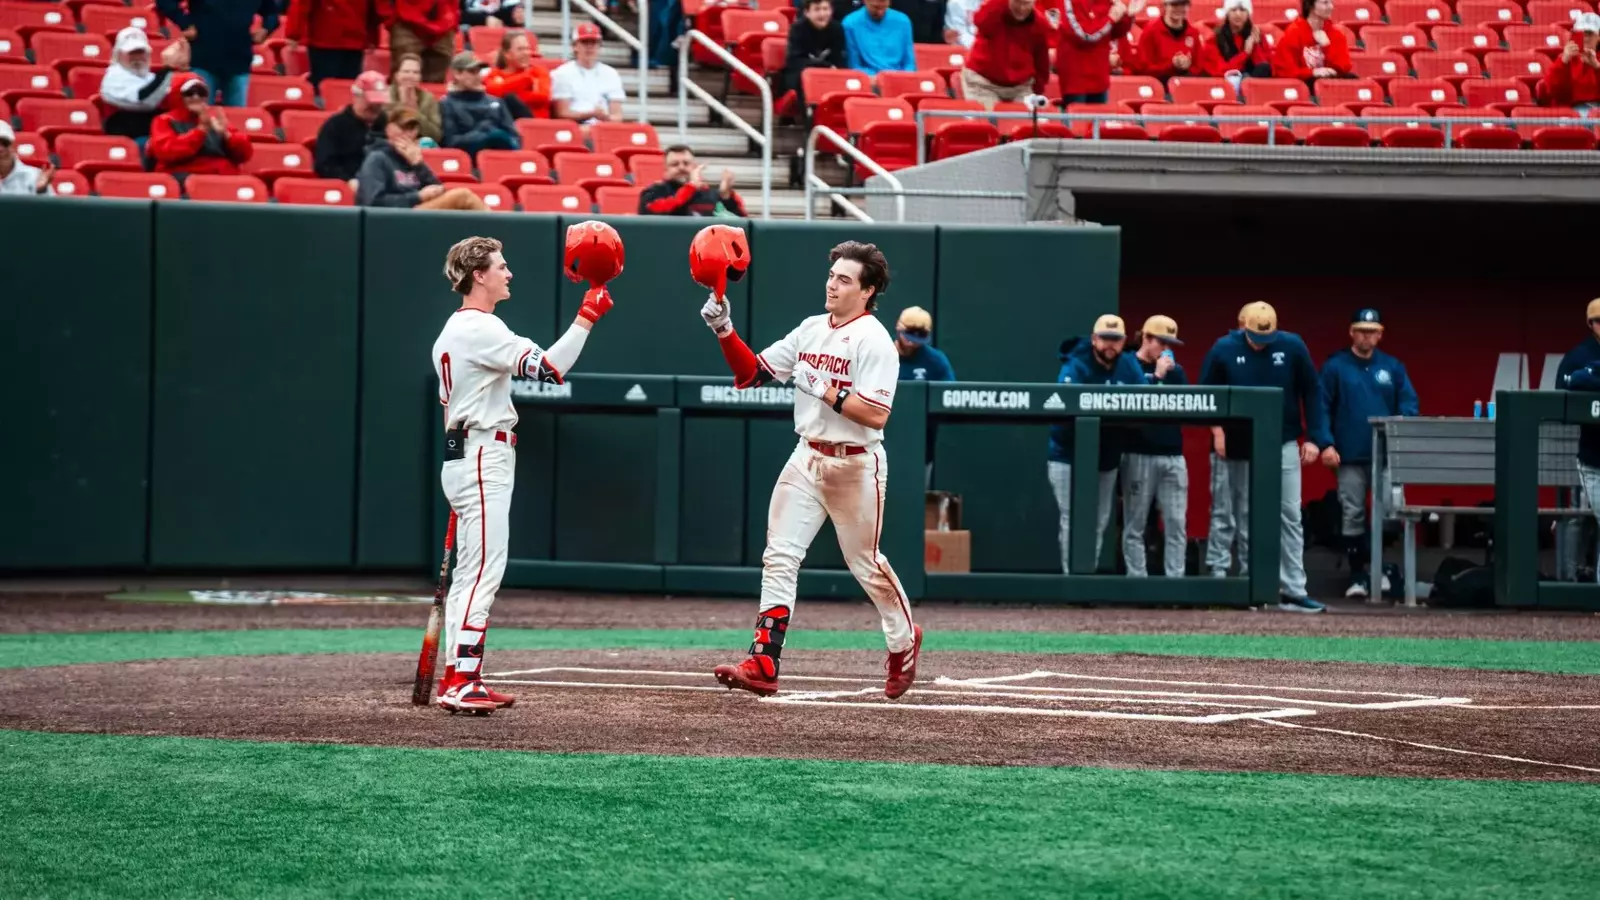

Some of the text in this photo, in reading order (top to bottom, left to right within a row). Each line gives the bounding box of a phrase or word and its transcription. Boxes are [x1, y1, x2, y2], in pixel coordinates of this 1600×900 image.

[798, 352, 851, 376] WOFPACK
[701, 385, 796, 404] @NCSTATEBAS
[943, 390, 1030, 410] GOPACK.COM
[1079, 392, 1218, 411] @NCSTATEBASEBALL
